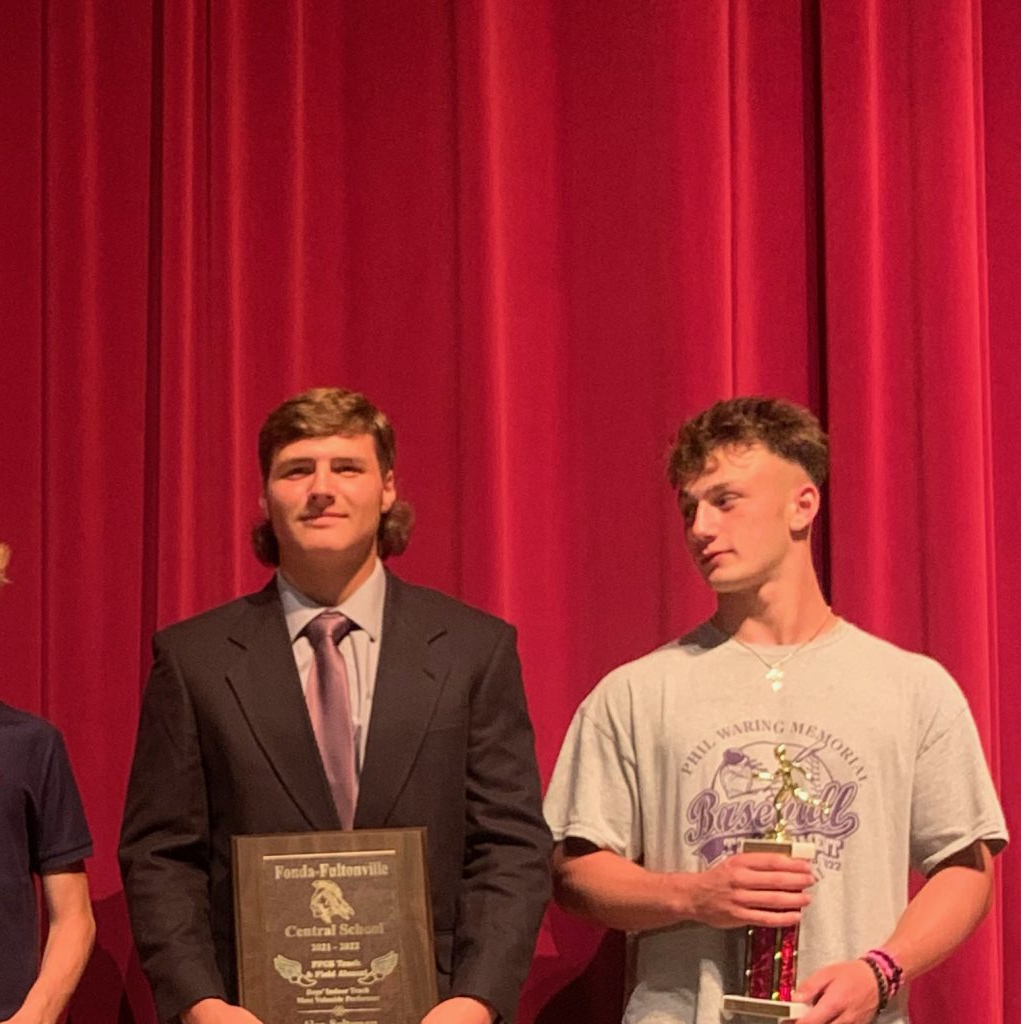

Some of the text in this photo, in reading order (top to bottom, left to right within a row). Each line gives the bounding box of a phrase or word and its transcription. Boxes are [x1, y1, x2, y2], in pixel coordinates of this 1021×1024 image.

[681, 719, 868, 783] PHIL WARING MEMORIAL
[275, 862, 389, 879] Fonda-Fultonville
[284, 922, 385, 938] Central School
